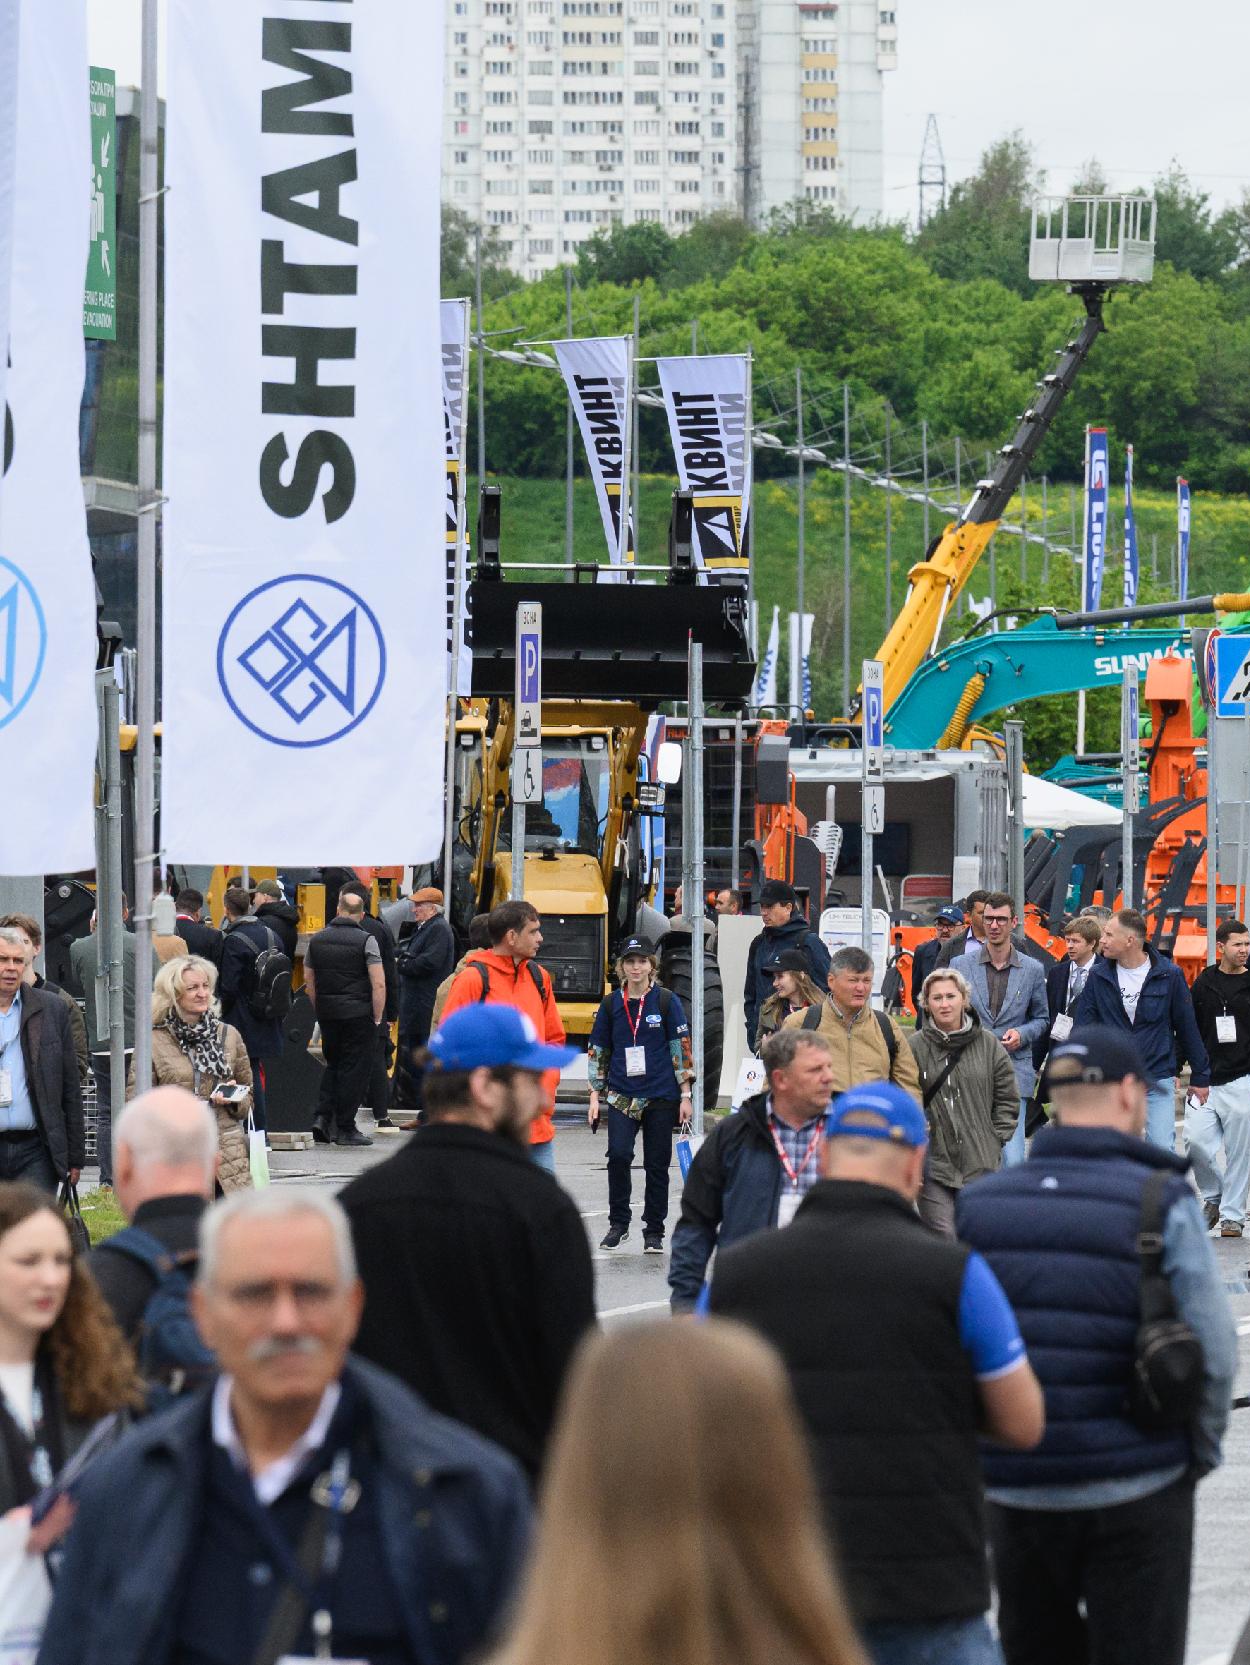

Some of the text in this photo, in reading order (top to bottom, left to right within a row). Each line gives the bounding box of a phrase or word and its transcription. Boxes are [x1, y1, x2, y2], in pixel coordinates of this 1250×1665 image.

[260, 0, 359, 524] SHTAM
[573, 374, 623, 479] КВИНТ
[672, 391, 730, 491] КВИНТ
[525, 640, 537, 697] P
